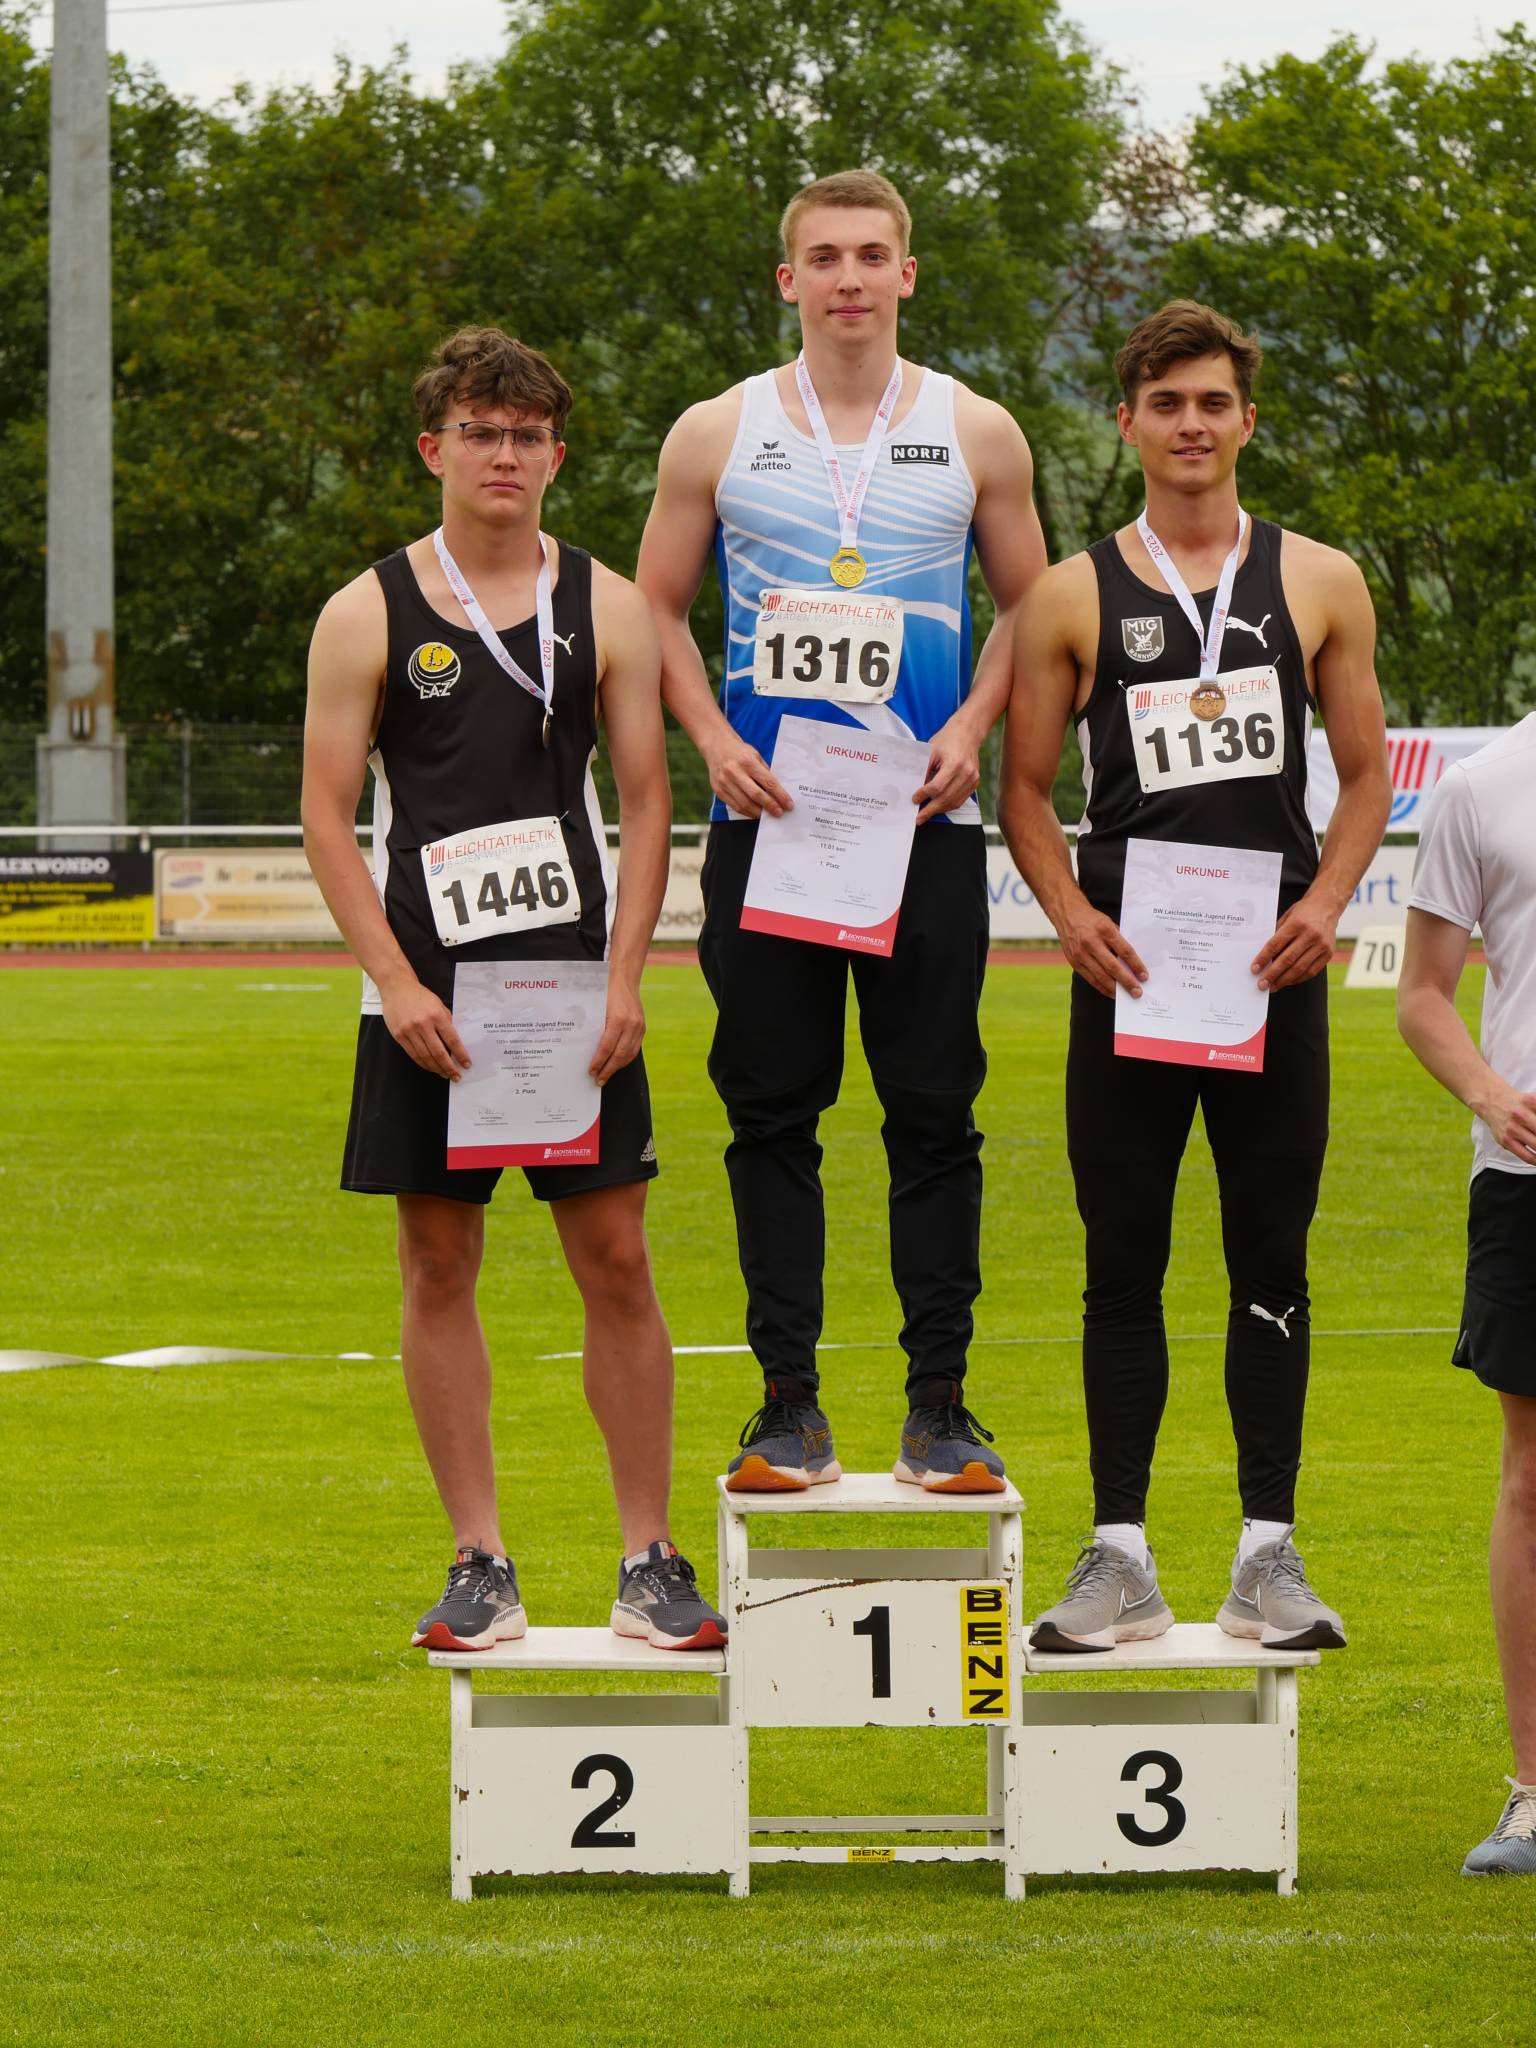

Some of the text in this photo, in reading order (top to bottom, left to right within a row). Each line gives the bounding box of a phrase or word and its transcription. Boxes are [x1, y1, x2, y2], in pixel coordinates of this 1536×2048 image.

[755, 451, 786, 461] erima
[893, 446, 949, 461] NORFI
[750, 461, 792, 472] Matteo
[1146, 534, 1164, 559] 2023
[780, 600, 897, 621] LEICHTATHLETIK
[1126, 619, 1158, 632] MTG
[543, 639, 552, 668] 2023
[765, 633, 891, 688] 1316
[420, 681, 452, 699] LAZ
[825, 744, 880, 763] URKUNDE
[1144, 712, 1276, 774] 1136
[447, 829, 557, 860] LEICHTATHLETIK
[1176, 865, 1231, 879] URKUNDE
[441, 861, 569, 926] 1446
[1364, 942, 1395, 972] 70
[504, 980, 559, 989] URKUNDE
[853, 1605, 891, 1699] 1
[966, 1588, 1004, 1715] BENZ
[570, 1753, 636, 1849] 2
[1116, 1749, 1187, 1848] 3
[852, 1849, 891, 1857] BENZ
